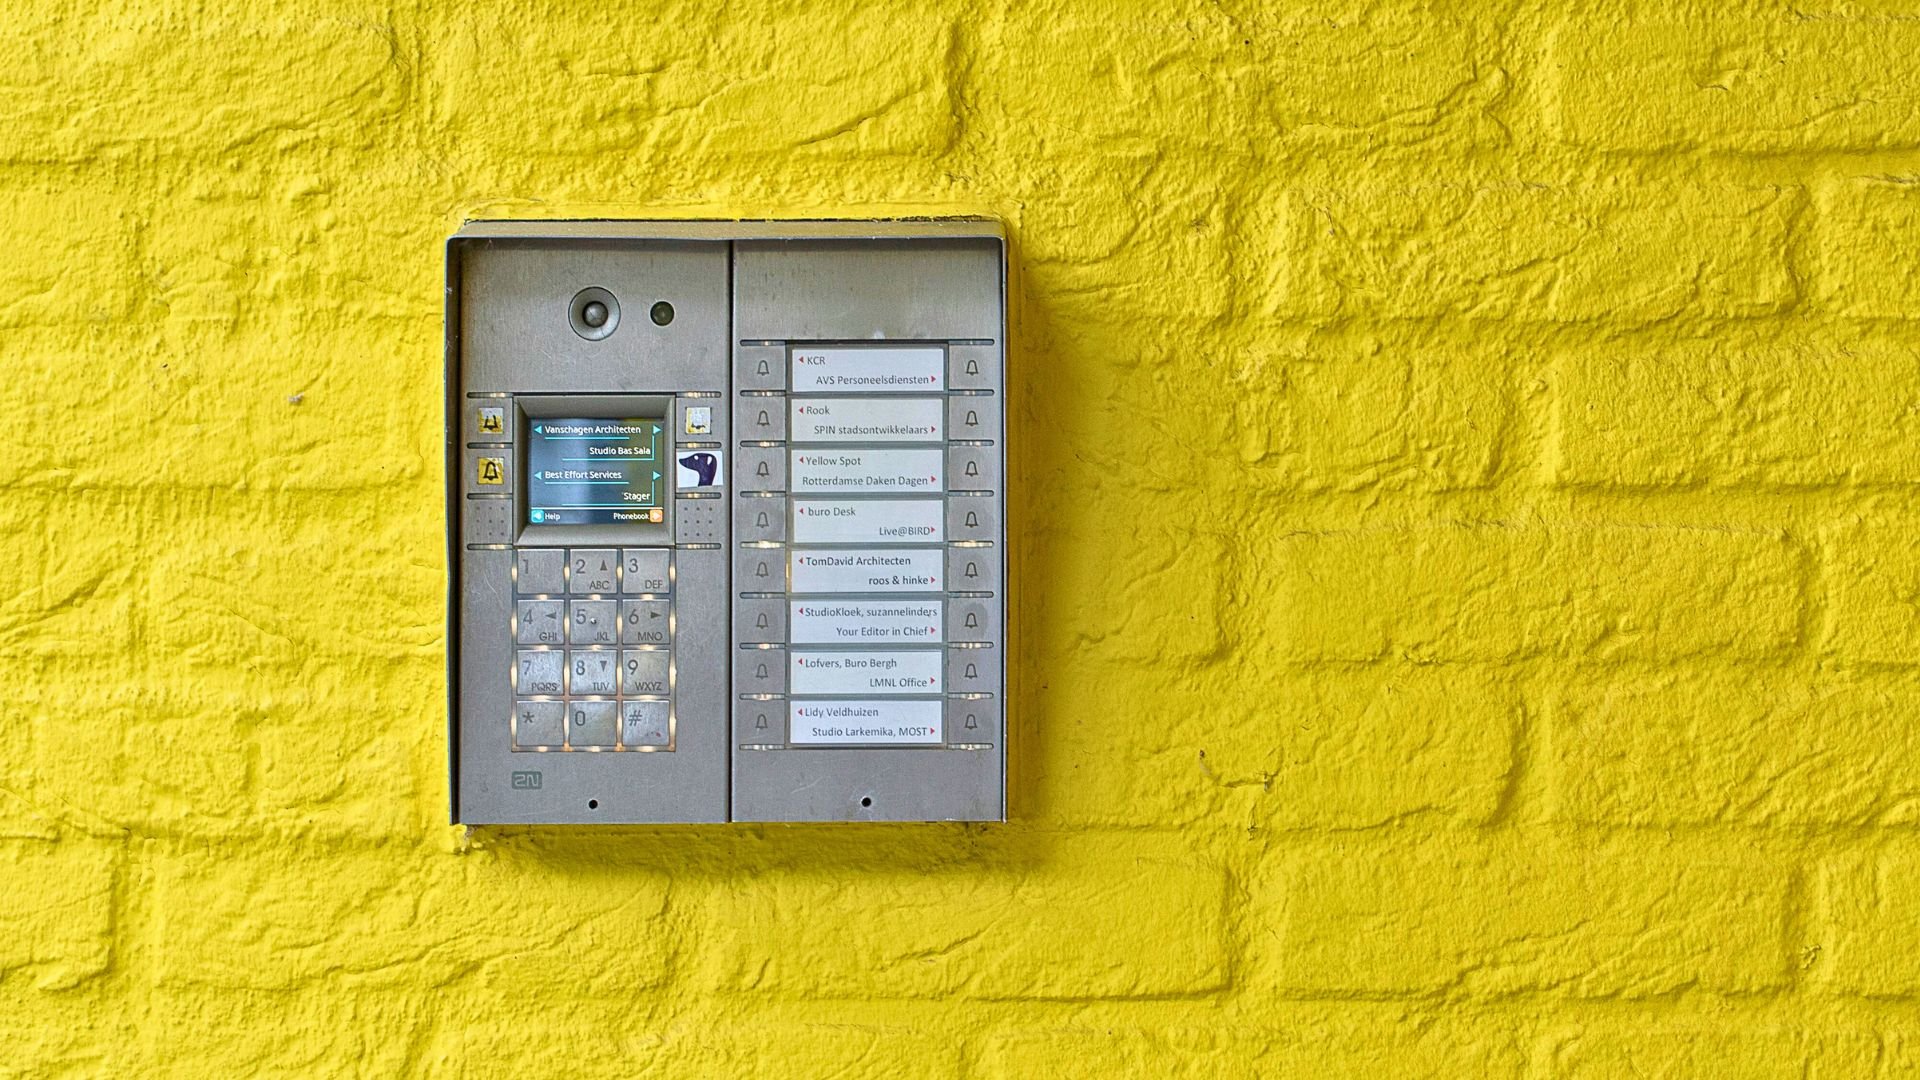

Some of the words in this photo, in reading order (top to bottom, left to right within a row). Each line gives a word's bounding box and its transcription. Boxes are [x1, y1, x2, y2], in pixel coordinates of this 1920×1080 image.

[807, 356, 825, 365] KCR
[816, 376, 835, 385] AVS
[838, 375, 929, 385] Personeelsdiensten
[806, 406, 830, 415] Rook
[545, 425, 593, 435] Vanschagen
[595, 425, 641, 433] Architecten
[814, 426, 836, 435] SPIN
[839, 425, 928, 434] stadsontwikkelaars
[589, 447, 616, 455] Studio
[618, 447, 632, 455] Bas
[806, 456, 837, 465] Yellow
[840, 457, 861, 467] Spot
[545, 471, 562, 479] Best
[565, 471, 588, 479] Effort
[590, 471, 622, 479] Services
[802, 476, 863, 485] Rotterdamse
[866, 476, 896, 485] Daken
[898, 476, 928, 487] Dagen
[624, 492, 650, 501] Stager
[808, 507, 830, 516] buro
[833, 507, 856, 516] Desk
[879, 527, 930, 537] Live@BIRD
[629, 558, 638, 573] 3
[806, 556, 853, 566] TomDavid
[856, 556, 911, 565] Architecten
[523, 559, 529, 574] 1
[575, 559, 586, 574] 2
[589, 581, 610, 590] ABC
[645, 580, 663, 589] DEF
[892, 576, 900, 585] &
[902, 576, 928, 585] hinke
[523, 609, 533, 624] 4
[576, 609, 586, 624] 5
[629, 609, 639, 624] 6
[805, 607, 864, 617] StudioKloek,
[866, 607, 937, 617] suzannelinders
[539, 631, 557, 641] GHI
[594, 631, 610, 641] JKL
[638, 631, 662, 641] MNO
[836, 627, 858, 636] Your
[861, 627, 889, 636] Editor
[892, 627, 900, 636] in
[903, 626, 928, 636] Chief
[522, 660, 531, 675] 7
[576, 660, 585, 675] 8
[628, 659, 638, 675] 9
[805, 659, 842, 668] Lofvers,
[845, 659, 867, 668] Buro
[870, 659, 897, 669] Bergh
[531, 682, 558, 691] PQRS
[592, 682, 609, 691] TUV
[634, 682, 662, 690] WXYZ
[869, 678, 897, 687] LMNL
[899, 678, 927, 687] Office
[805, 708, 824, 718] Lidy
[826, 707, 879, 717] Veldhuizen
[575, 711, 586, 726] 0
[629, 710, 642, 726] #
[812, 727, 842, 737] Studio
[846, 727, 896, 737] Larkemika,
[899, 727, 927, 736] MOST
